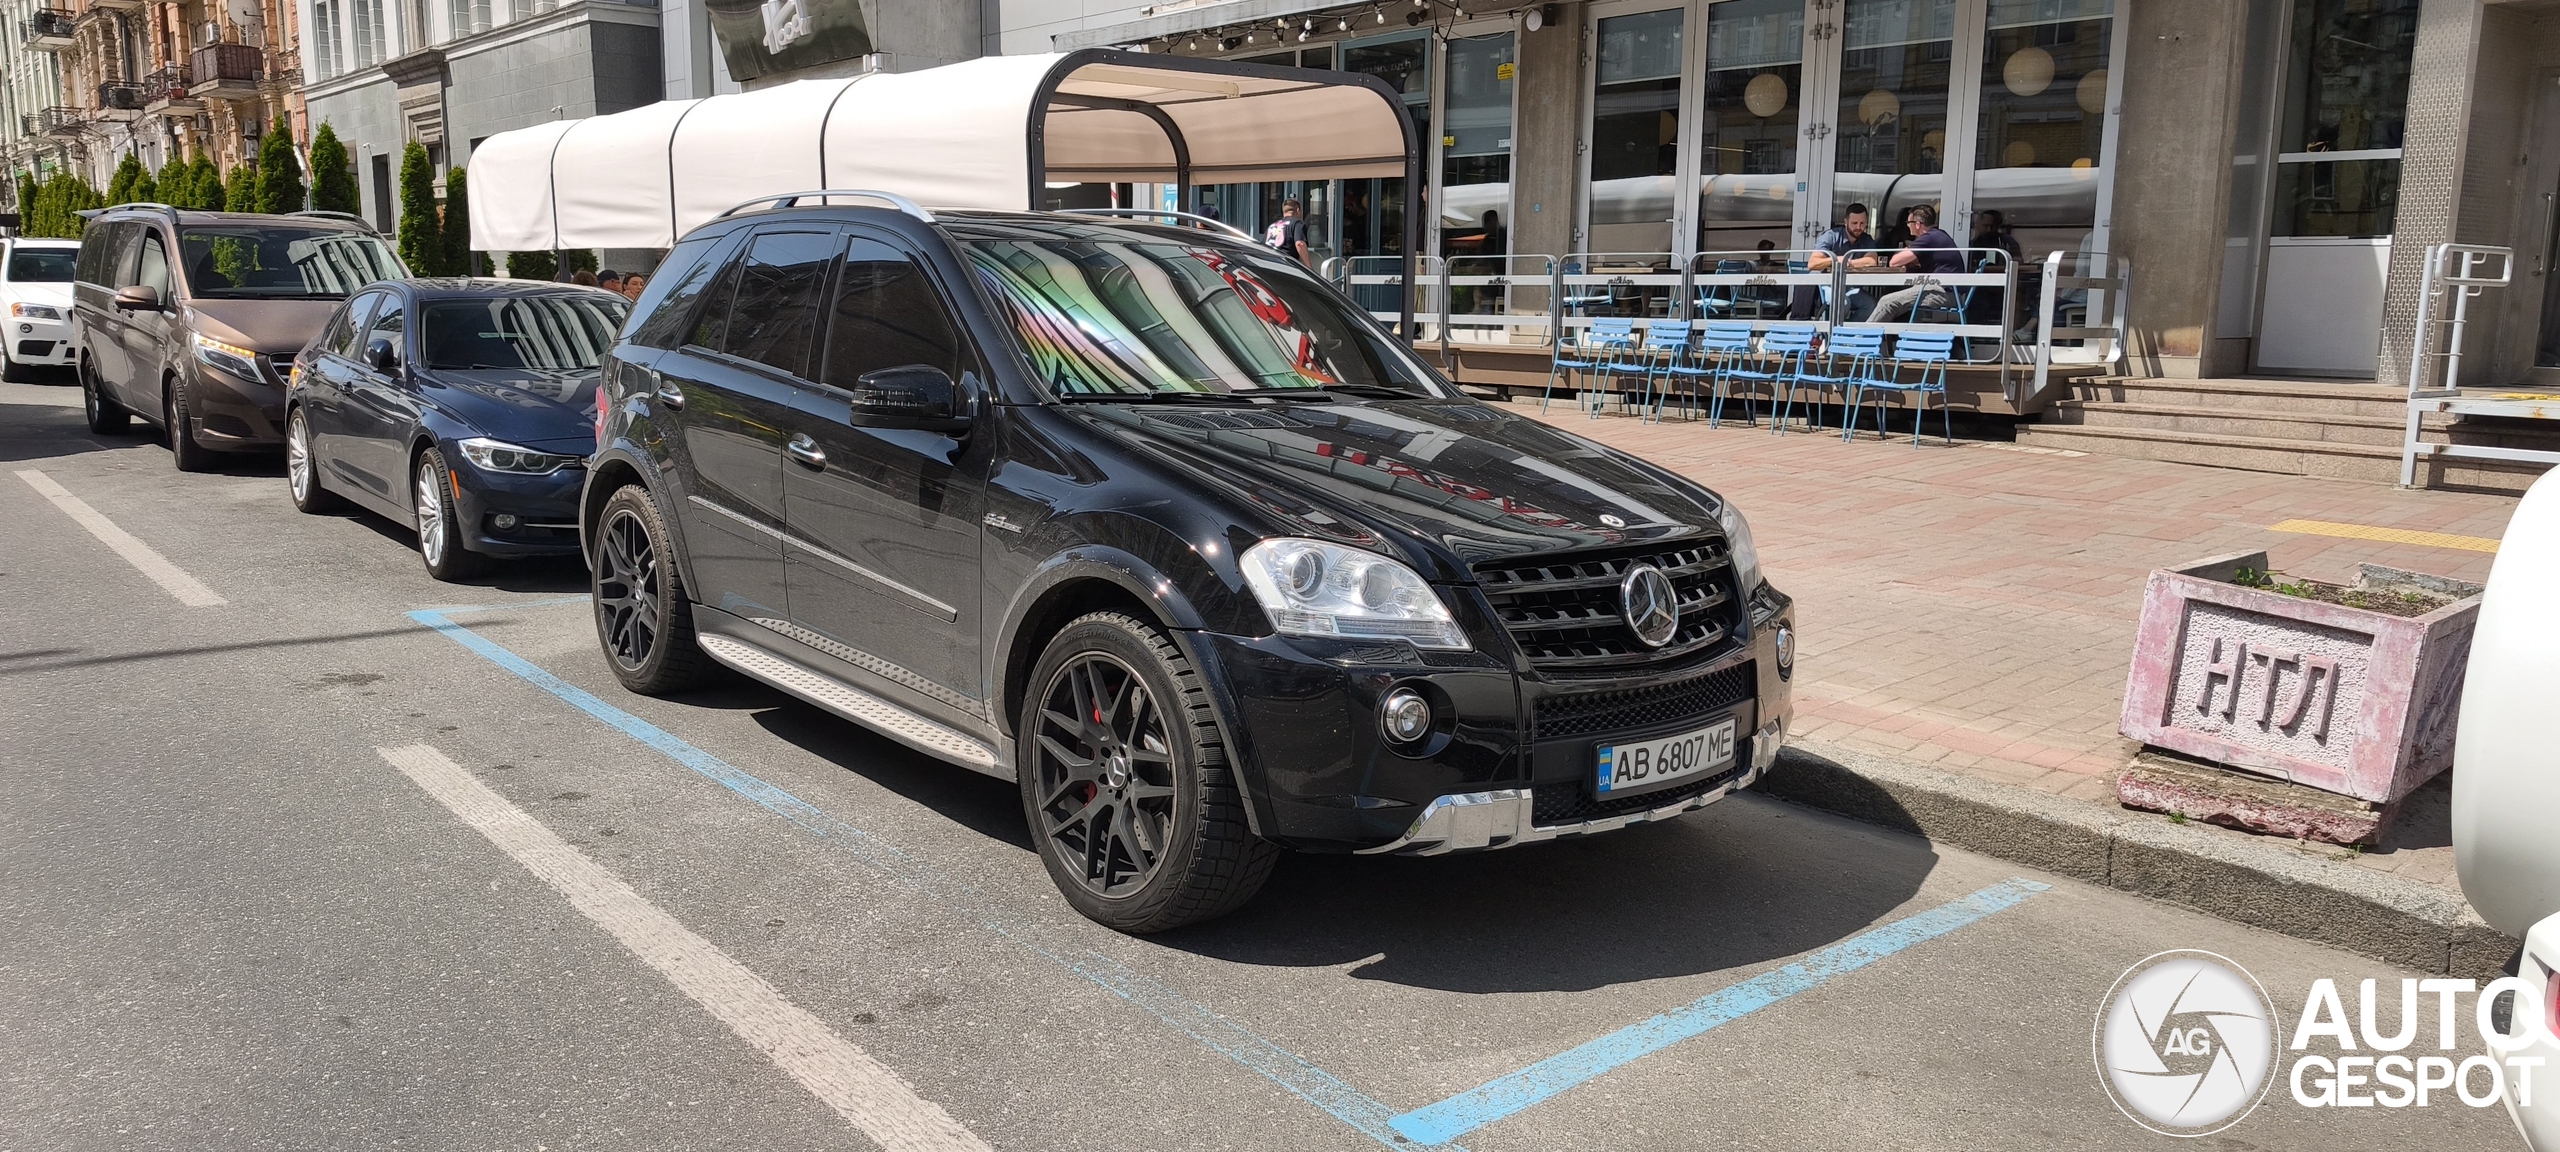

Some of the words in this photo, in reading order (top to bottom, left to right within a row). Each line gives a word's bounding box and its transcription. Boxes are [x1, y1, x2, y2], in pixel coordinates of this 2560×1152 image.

[1607, 275, 1635, 286] milkbar
[1745, 275, 1777, 286] milkbar
[1904, 275, 1941, 286] milkbar
[2196, 633, 2339, 737] НТЛ
[1614, 747, 1650, 783] AB
[1656, 735, 1704, 774] 6807
[1707, 726, 1732, 762] ME
[1598, 775, 1610, 787] UA
